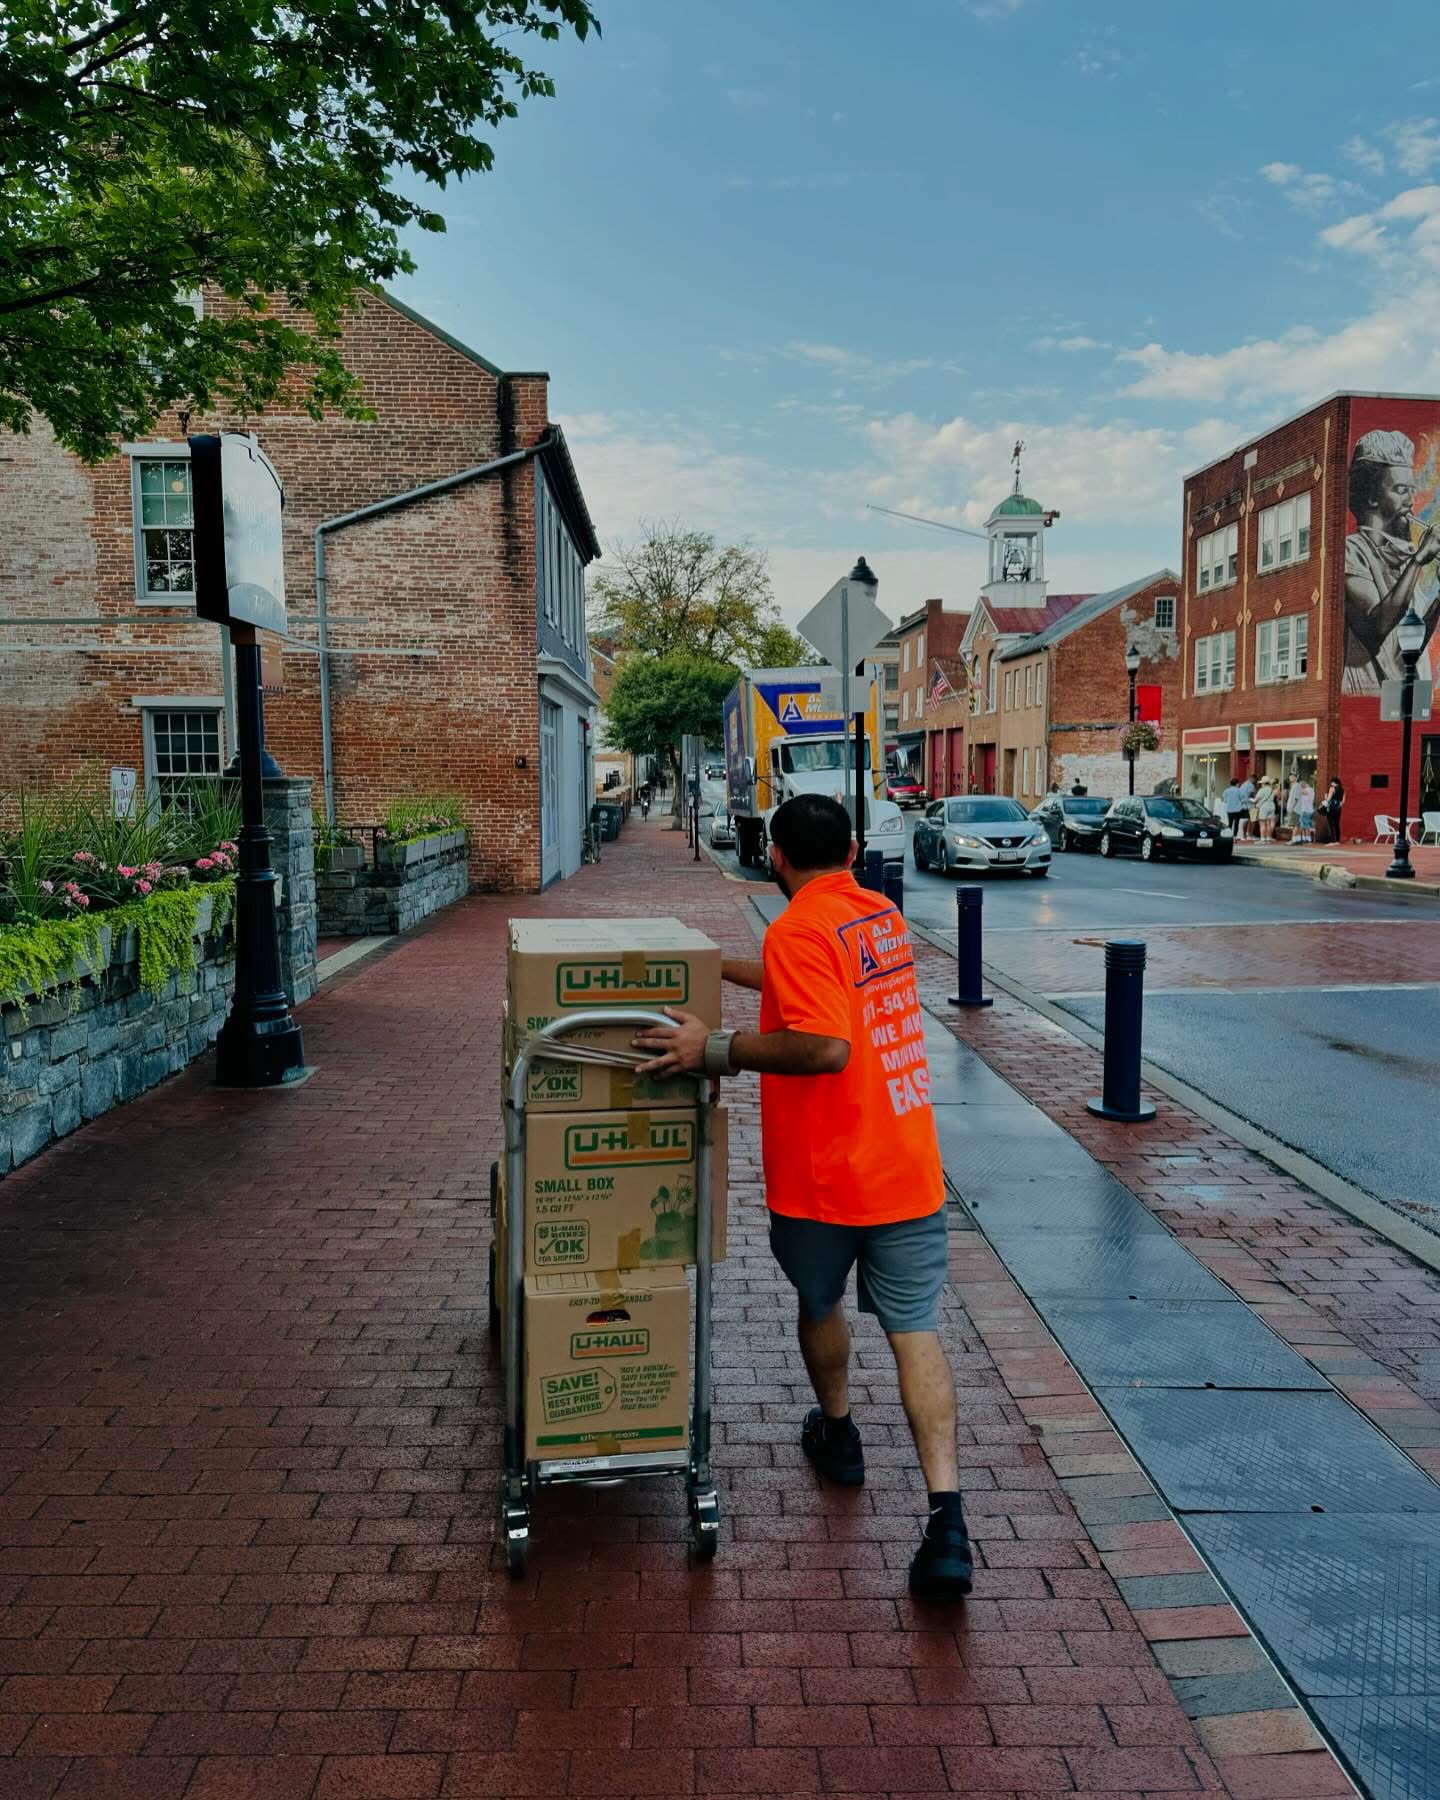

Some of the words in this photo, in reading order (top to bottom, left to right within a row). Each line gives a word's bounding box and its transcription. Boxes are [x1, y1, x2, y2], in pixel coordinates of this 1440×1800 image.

[566, 968, 681, 990] U-HUL
[871, 1023, 899, 1048] WE
[547, 1077, 578, 1091] OK
[887, 1067, 931, 1117] EAS
[574, 1128, 688, 1152] U-HUL
[534, 1178, 582, 1194] SMALL
[587, 1177, 615, 1191] BOX
[554, 1239, 585, 1254] OK
[575, 1333, 646, 1350] U-HAUL
[546, 1372, 600, 1395] SAVE!
[548, 1395, 572, 1409] BEST
[573, 1391, 600, 1406] PRICE
